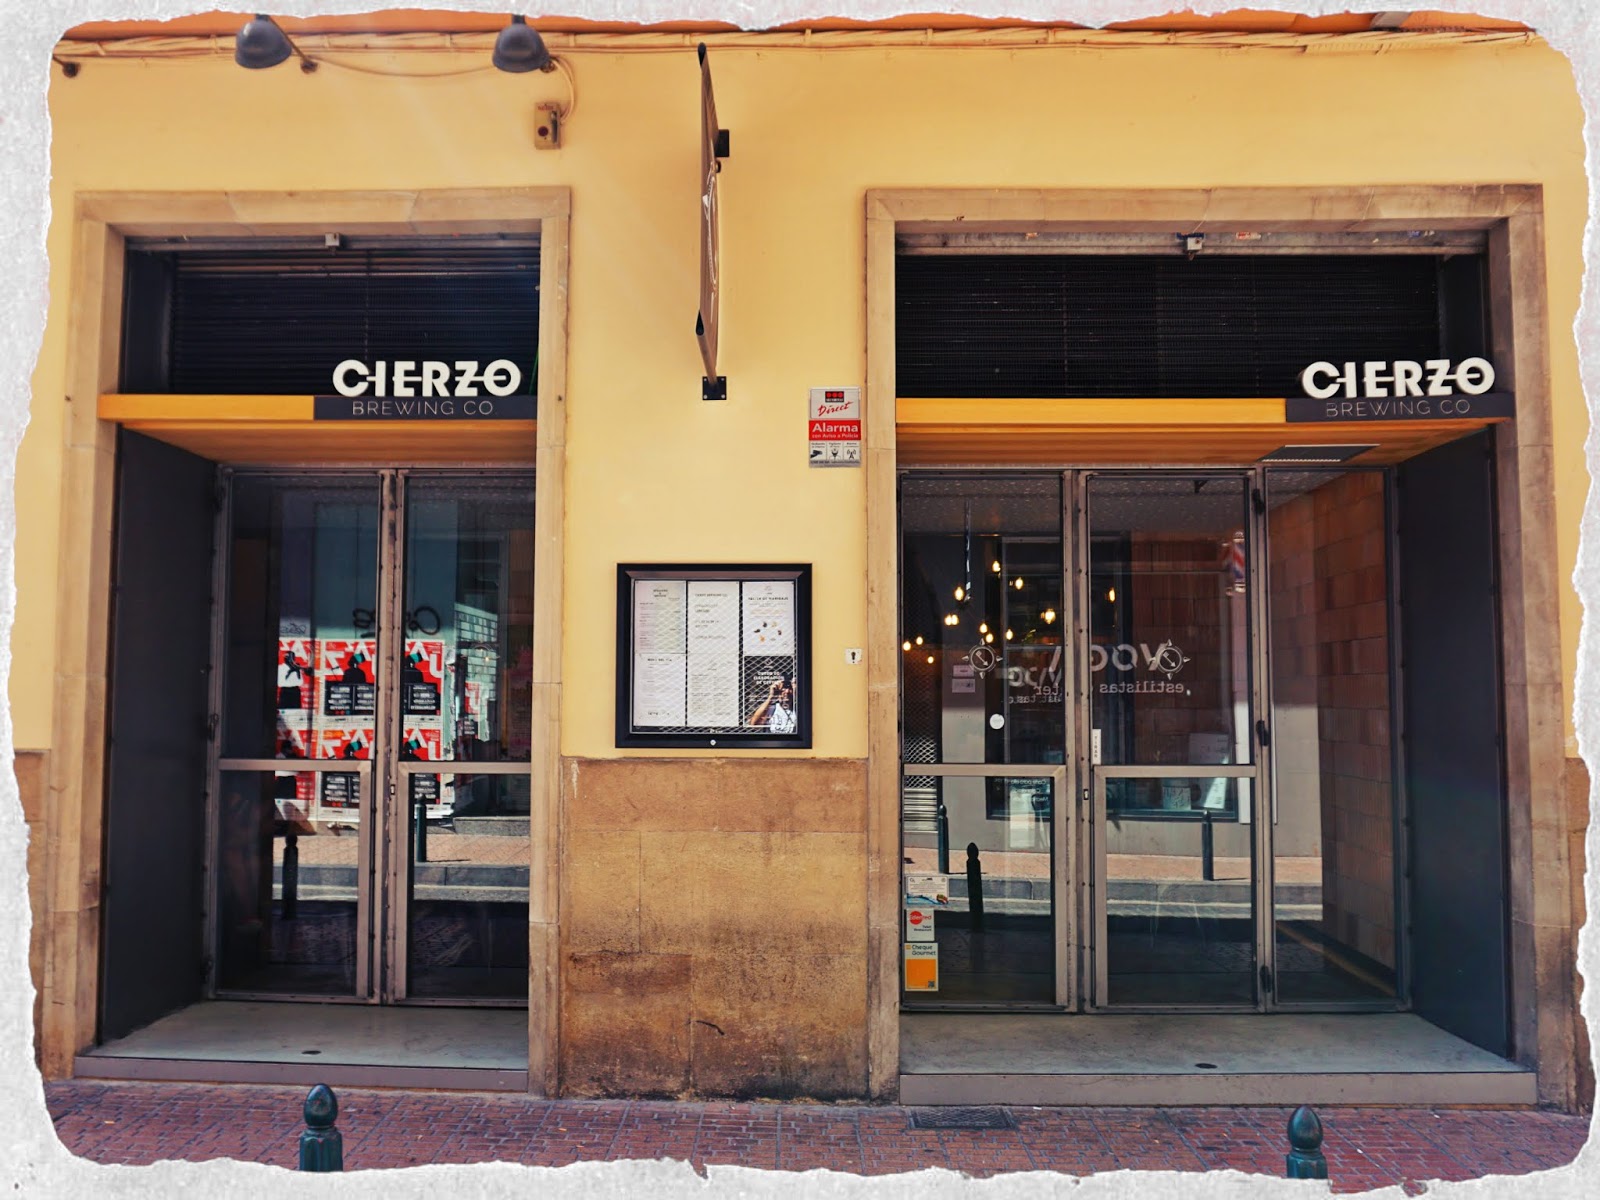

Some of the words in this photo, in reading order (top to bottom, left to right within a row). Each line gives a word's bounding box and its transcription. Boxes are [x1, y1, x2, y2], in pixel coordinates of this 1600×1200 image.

[332, 359, 521, 397] CIERZO
[1301, 357, 1495, 399] CIERZO
[352, 400, 454, 415] BREWING
[818, 401, 854, 417] Direct
[1326, 400, 1431, 417] BREWING
[812, 423, 859, 432] Alarma
